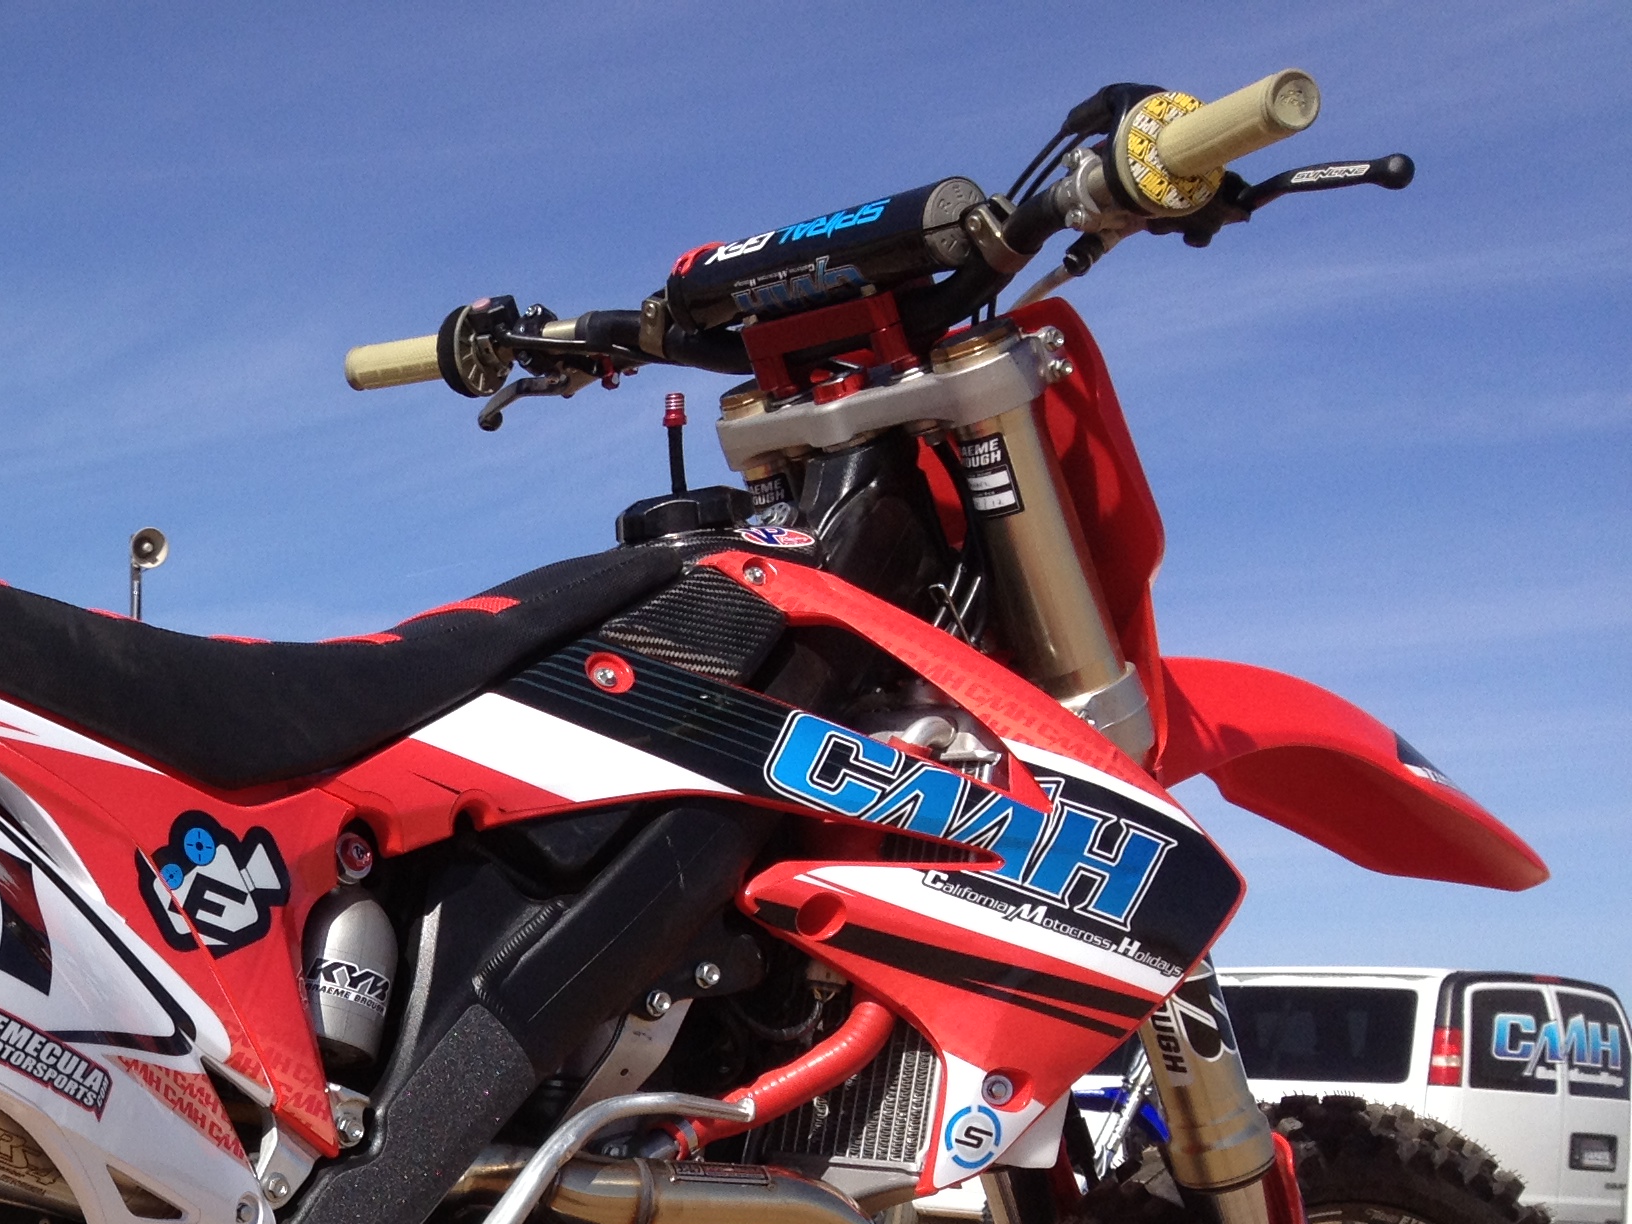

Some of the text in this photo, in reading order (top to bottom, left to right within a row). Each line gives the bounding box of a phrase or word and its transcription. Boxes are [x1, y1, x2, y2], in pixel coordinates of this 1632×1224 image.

[764, 710, 1178, 932] CMH
[925, 869, 1184, 977] California Motocross Holidays
[1492, 1013, 1621, 1076] CMH
